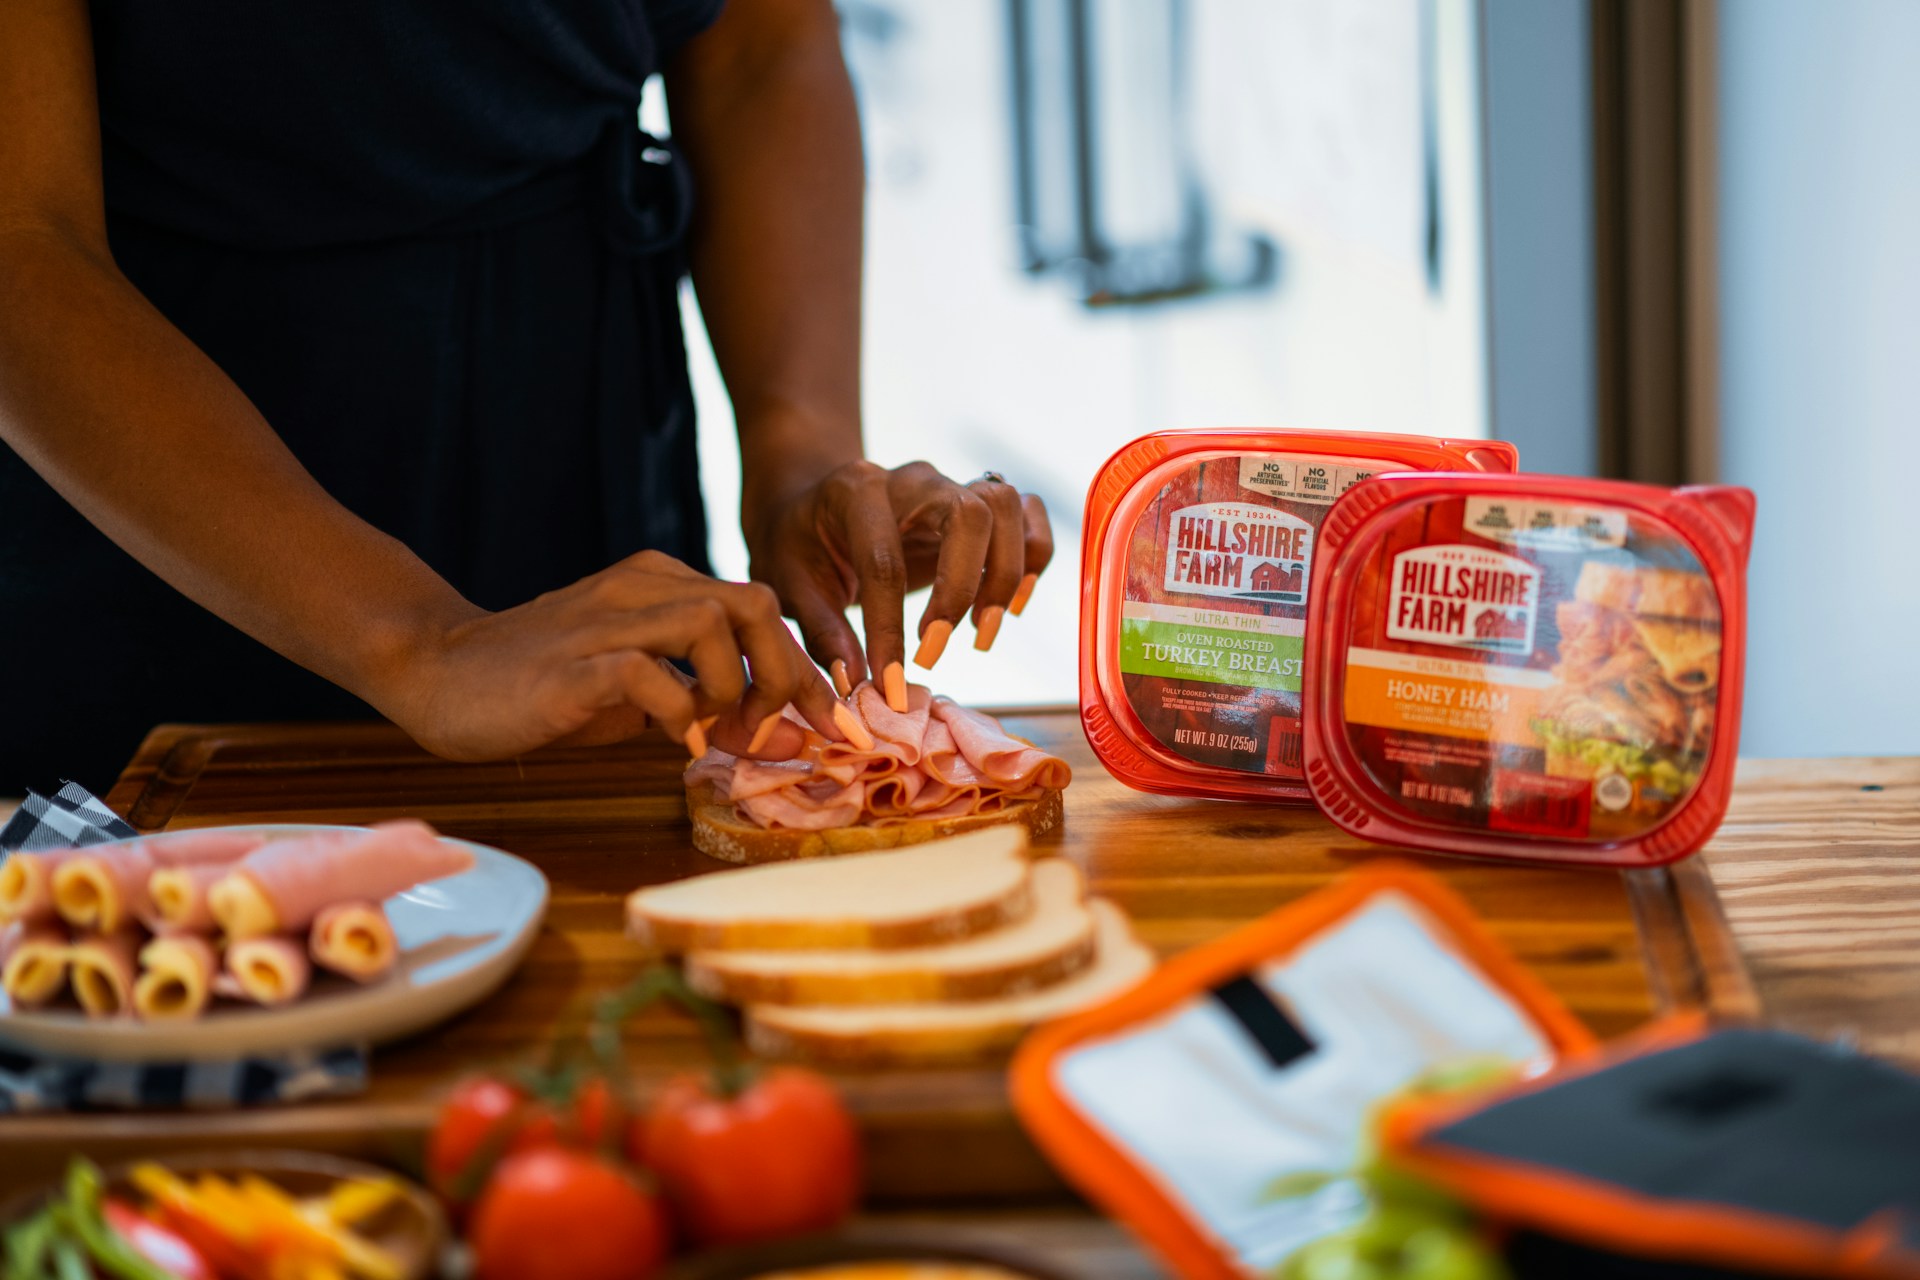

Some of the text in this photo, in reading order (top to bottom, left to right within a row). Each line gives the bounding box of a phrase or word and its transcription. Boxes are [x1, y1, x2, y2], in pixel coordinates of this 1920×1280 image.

[1257, 472, 1283, 480] ARTIFICIAL
[1263, 463, 1279, 472] NO
[1309, 467, 1325, 477] NO
[1303, 476, 1329, 485] ARTIFICIAL
[1304, 483, 1326, 491] FLAVORS
[1218, 508, 1271, 520] EST 1934
[1177, 516, 1307, 561] HILLSHIRE
[1174, 550, 1243, 588] FARM
[1402, 560, 1533, 606] HILLSHIRE
[1194, 612, 1261, 629] ULTRA THIN
[1397, 596, 1466, 635] FARM
[1177, 632, 1274, 653] OVEN ROASTED
[1142, 642, 1304, 677] TURKEY BREAST
[1162, 687, 1181, 695] FULLY
[1182, 689, 1207, 698] COOKED
[1212, 692, 1229, 701] KEEP
[1387, 679, 1455, 705] HONEY
[1460, 688, 1510, 714] HAM
[1174, 729, 1257, 753] NET WT. 9 OZ (255g)
